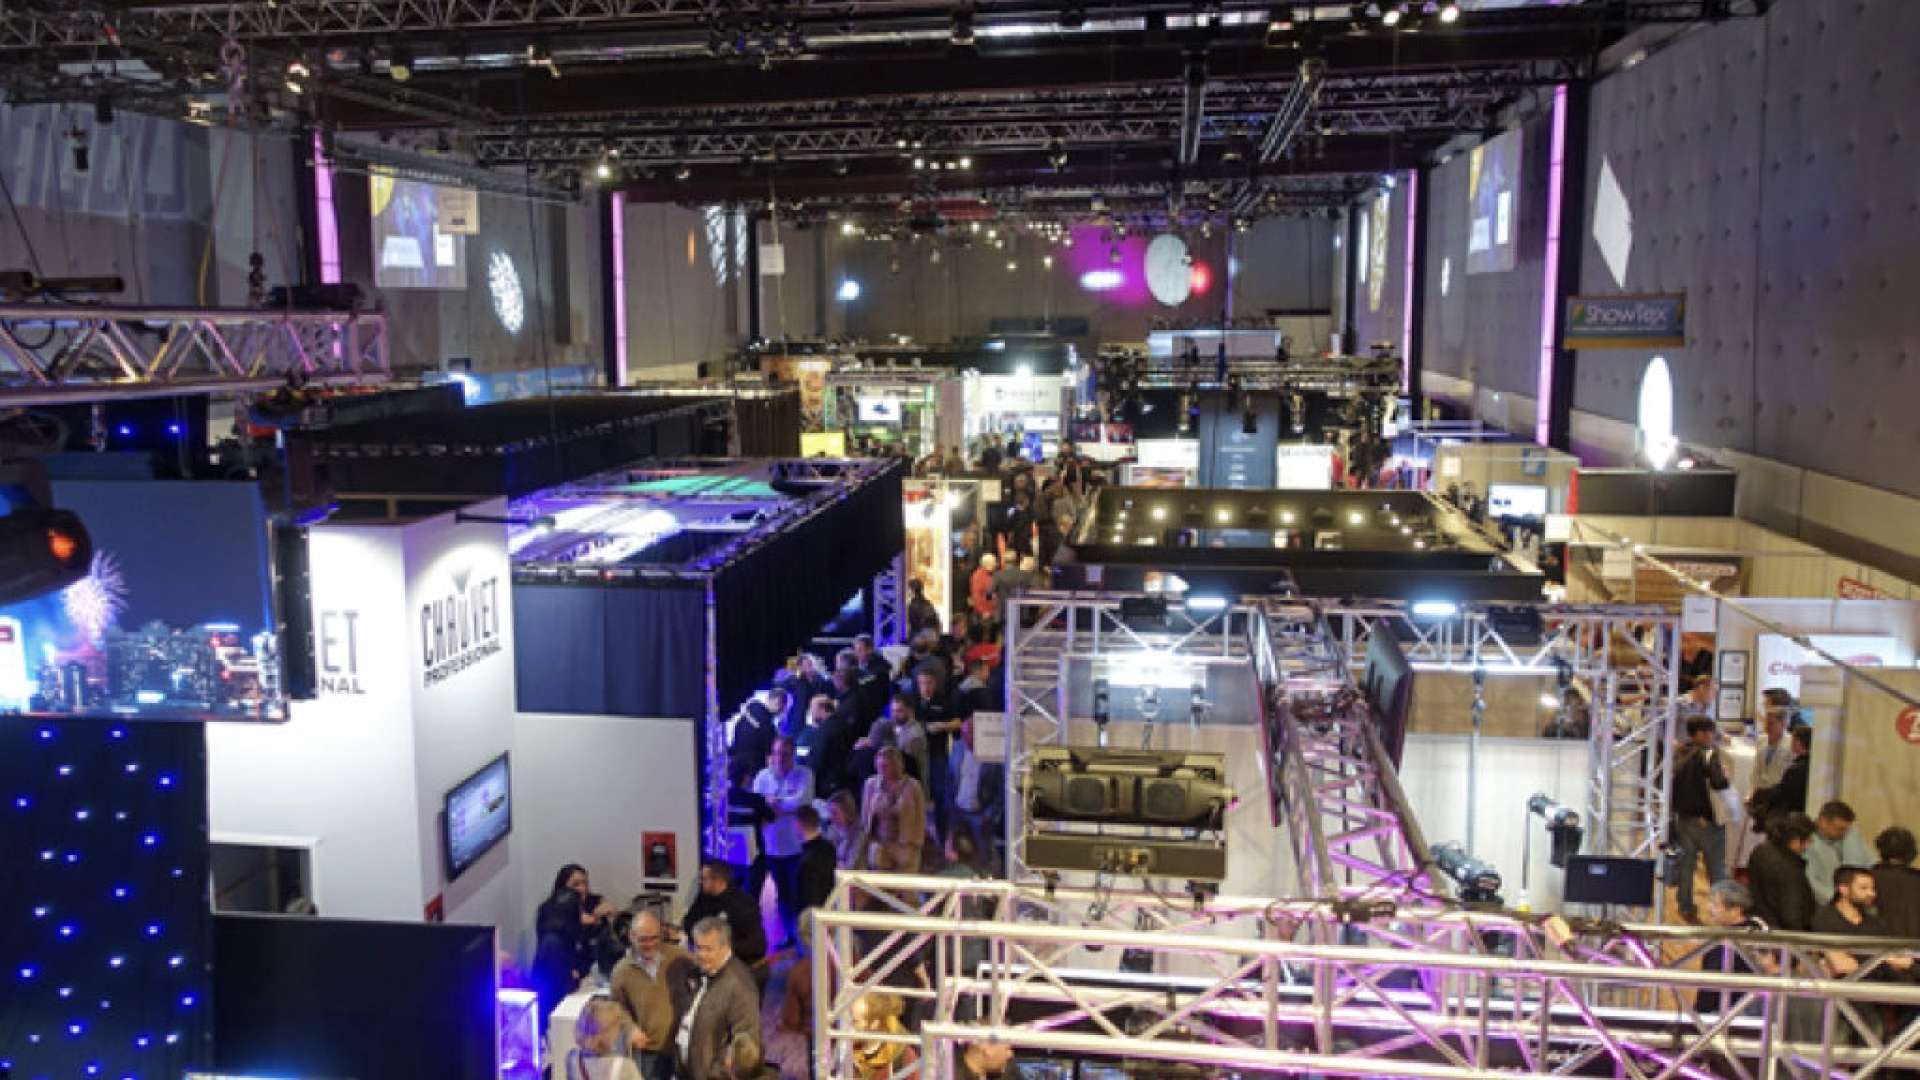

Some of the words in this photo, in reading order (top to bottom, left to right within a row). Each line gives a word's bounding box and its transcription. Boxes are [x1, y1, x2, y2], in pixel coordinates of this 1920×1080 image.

[1586, 303, 1668, 325] ShowTex
[420, 576, 499, 667] CHAUVET
[423, 637, 502, 688] PROFESSIONAL
